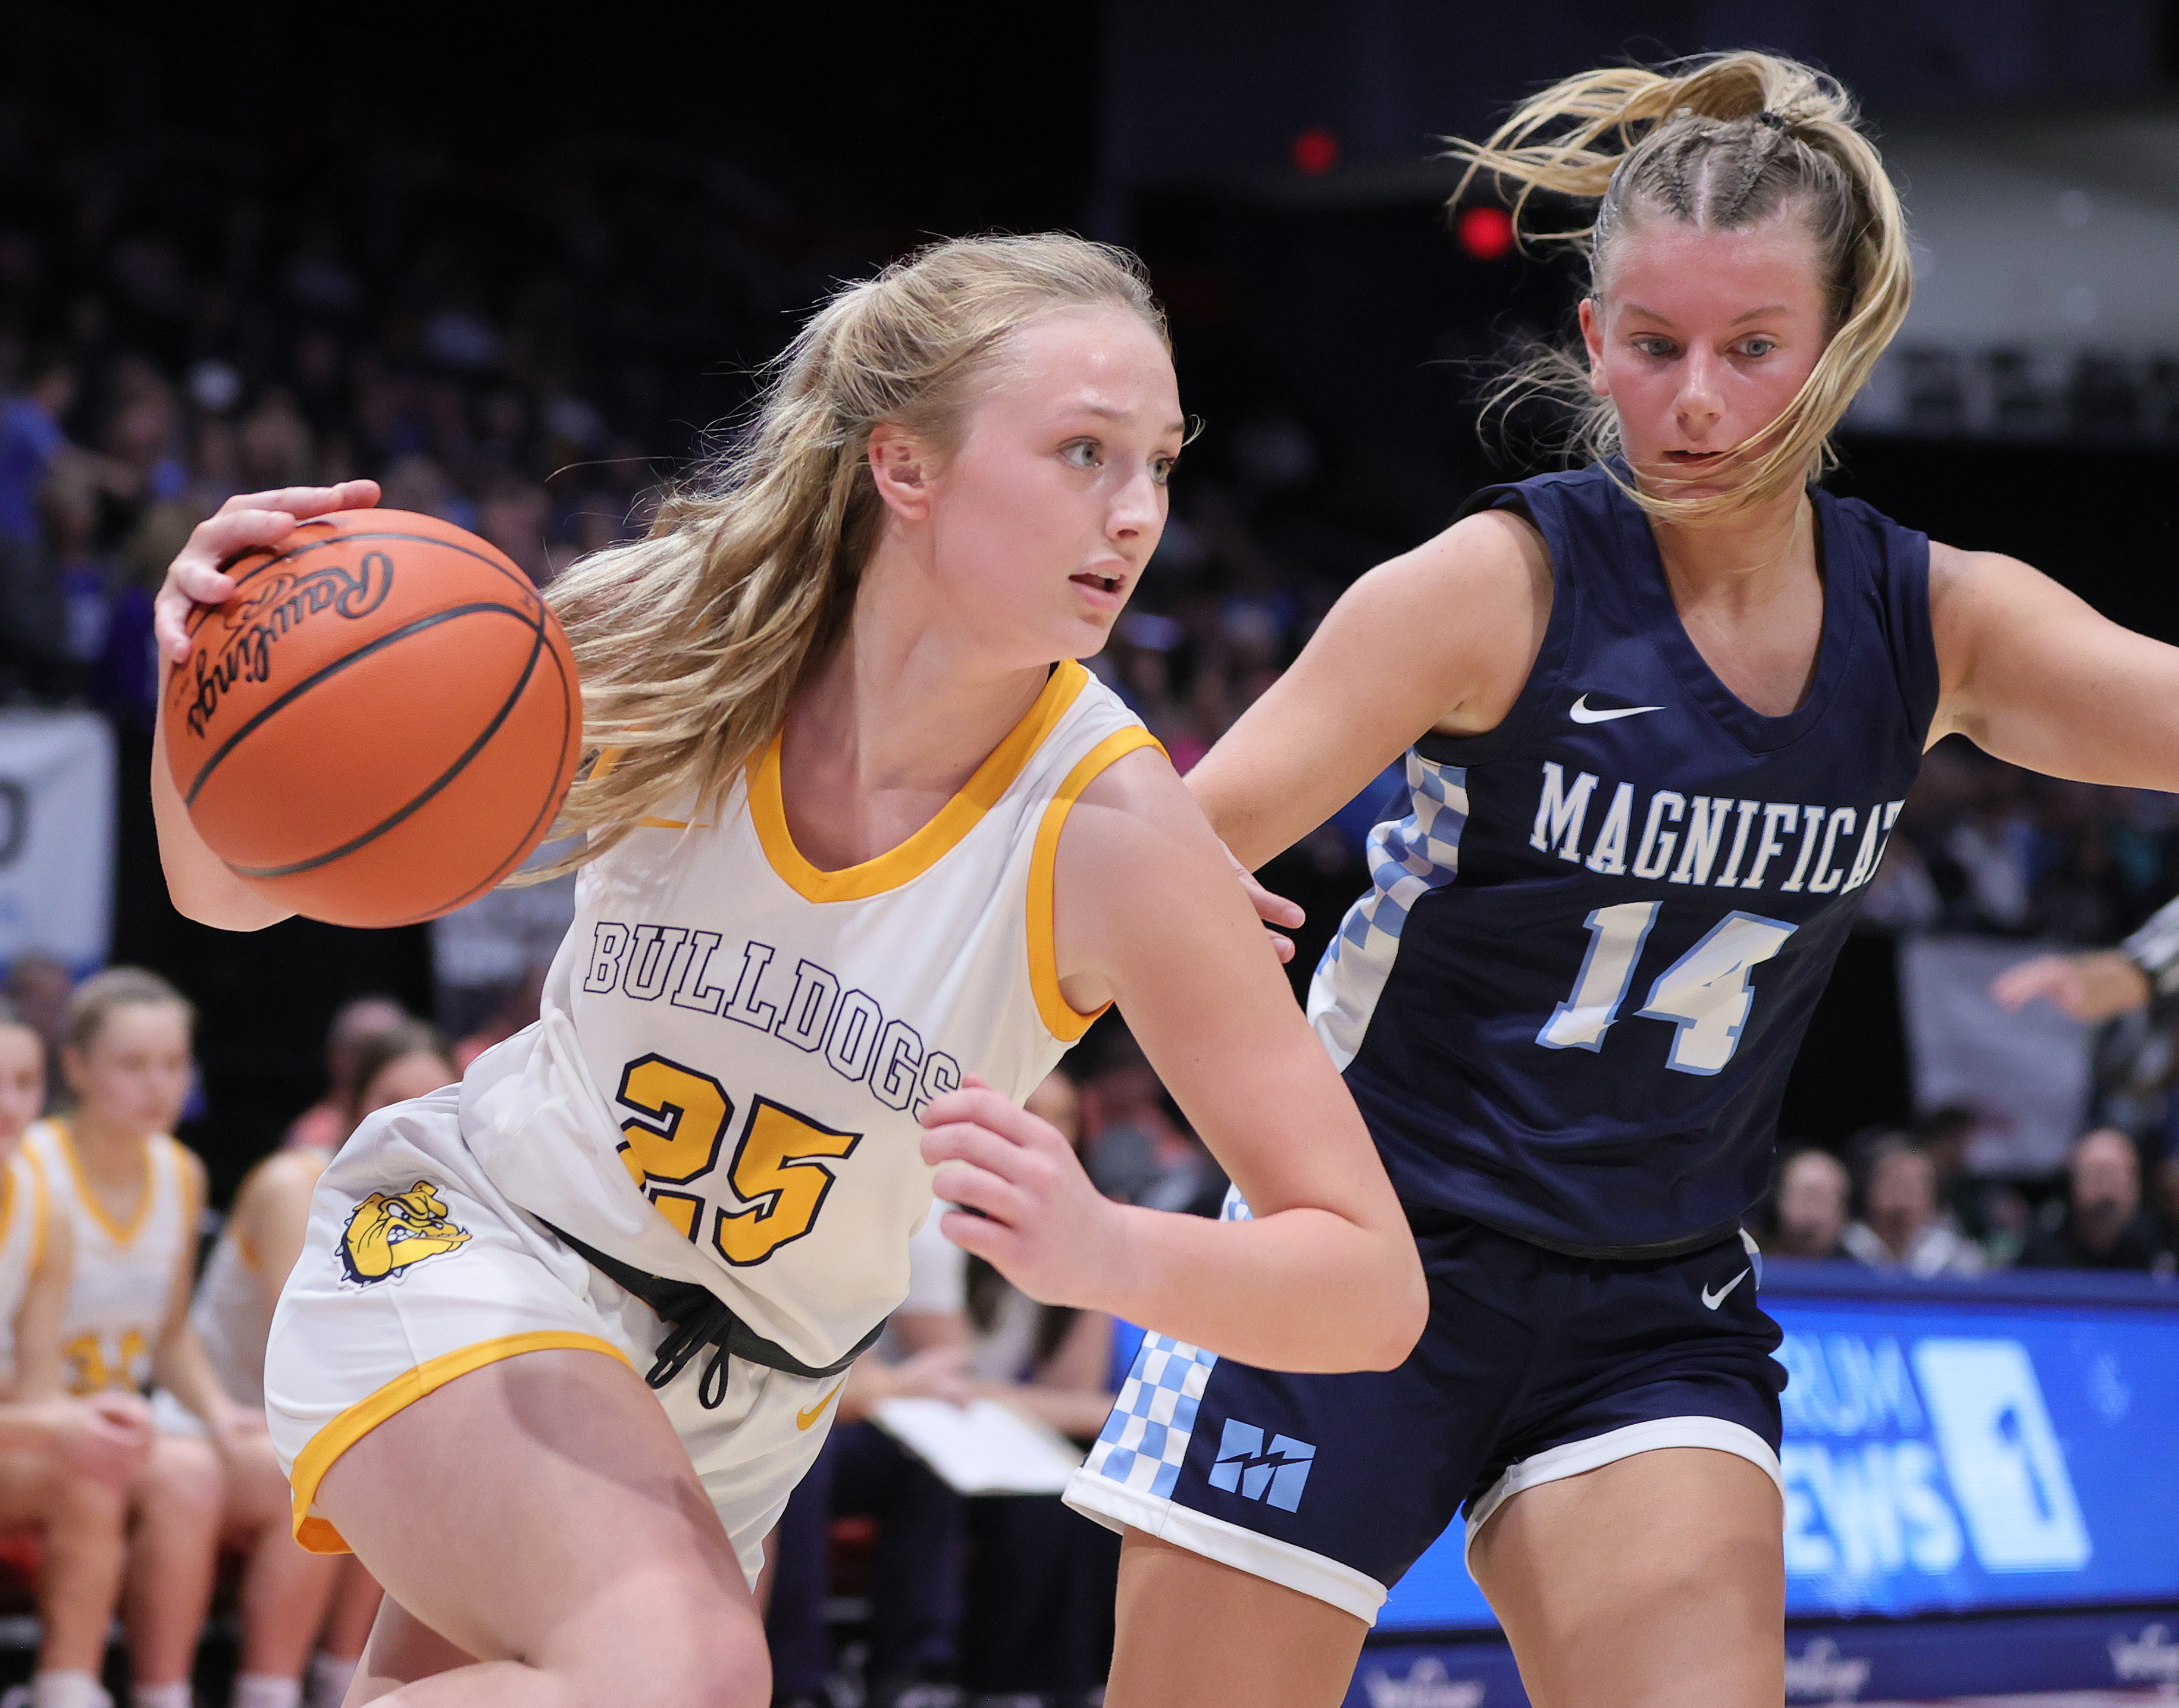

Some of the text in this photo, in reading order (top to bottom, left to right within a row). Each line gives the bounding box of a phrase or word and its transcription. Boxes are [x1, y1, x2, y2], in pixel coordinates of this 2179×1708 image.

[186, 550, 394, 739] Rawlings
[583, 921, 961, 1124] BULLDOGS
[1535, 900, 1800, 1076] 14
[615, 1052, 864, 1267] 25
